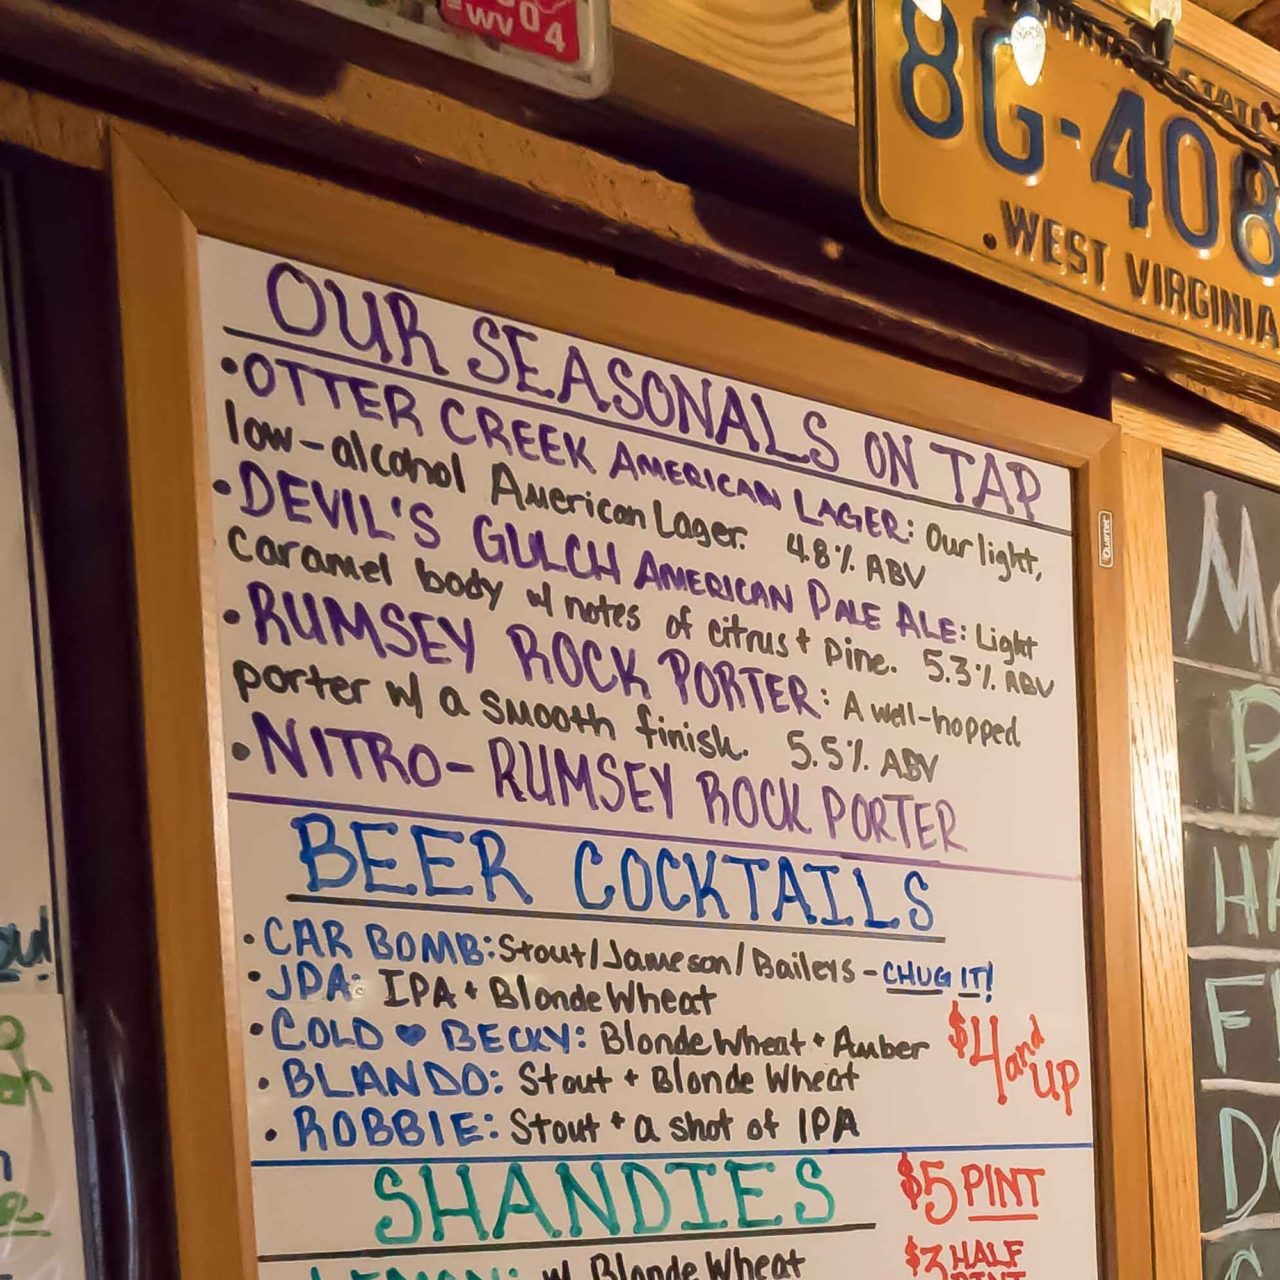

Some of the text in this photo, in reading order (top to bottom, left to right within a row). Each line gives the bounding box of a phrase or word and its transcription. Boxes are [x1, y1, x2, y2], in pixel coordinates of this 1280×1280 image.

[466, 3, 513, 37] WV
[1001, 200, 1109, 290] WEST
[266, 261, 1043, 521] OUR SEASONALS ON TAP
[225, 399, 467, 494] low-alcohol
[491, 462, 647, 532] American
[653, 500, 748, 551] Lager.
[866, 552, 927, 591] ABV
[243, 352, 1043, 582] OTTER CREEK AMERICAN LAGER: Our light,
[228, 525, 393, 587] caramel
[414, 557, 504, 611] body
[564, 594, 642, 631] notes
[665, 605, 693, 642] of
[708, 613, 789, 658] citrus
[1005, 669, 1056, 699] ABV
[239, 460, 1039, 666] DEVIL'S GULCH AMERICAN PALE ALE: Light
[246, 580, 1023, 750] RUMSEY ROCK PORTER: A well-hopped
[232, 659, 372, 704] porter
[438, 686, 472, 718] a
[481, 688, 617, 741] smooth
[635, 702, 751, 762] finish.
[880, 747, 940, 785] ABV
[487, 736, 675, 821] RUMSEY
[694, 769, 813, 837] ROCK
[820, 783, 969, 854] PORTER
[289, 812, 935, 933] BEER COCKTAILS
[263, 915, 355, 960] CAR
[364, 922, 497, 967] BOMB:
[882, 962, 953, 990] CHUG
[377, 967, 458, 1010] IPA
[488, 973, 603, 1014] Blonde
[605, 978, 718, 1016] Wheat
[271, 1006, 931, 1061] COLD BECKY: Blonde Wheat Amber
[281, 1057, 614, 1101] BLANDO: Stout
[946, 1000, 1081, 1117] $4 and UP
[292, 1105, 861, 1153] ROBBIE: Stout a shot of IPA
[373, 1156, 836, 1246] SHANDIES
[897, 1151, 1047, 1226] $5 PINT
[948, 1238, 1025, 1271] HALF
